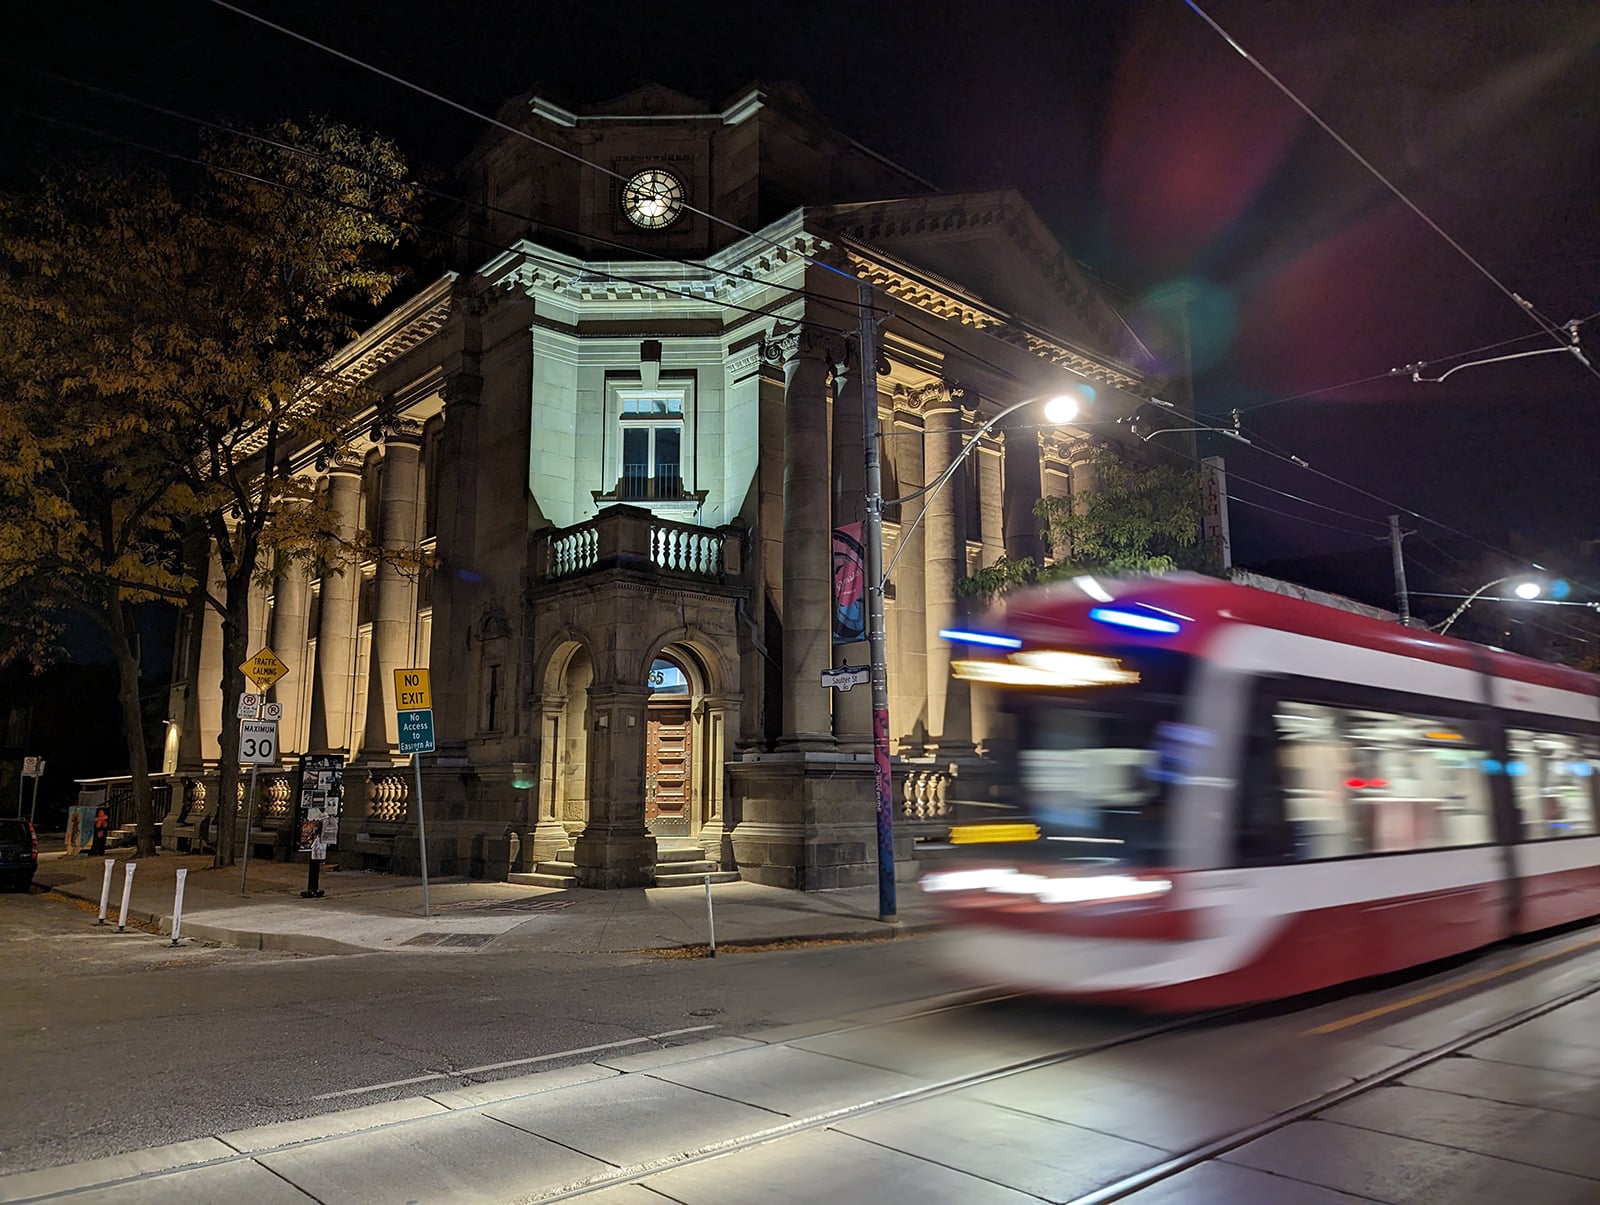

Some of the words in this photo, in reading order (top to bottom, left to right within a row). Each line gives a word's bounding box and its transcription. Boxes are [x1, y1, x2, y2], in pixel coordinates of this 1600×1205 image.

[254, 658, 277, 666] TRAFFIC
[253, 667, 277, 675] CALMING
[404, 674, 419, 686] NO
[402, 692, 424, 704] EXIT
[409, 713, 420, 721] No
[244, 725, 275, 733] MAXIMUM
[403, 723, 428, 731] Access
[243, 738, 272, 757] 30
[401, 742, 424, 750] Eastern
